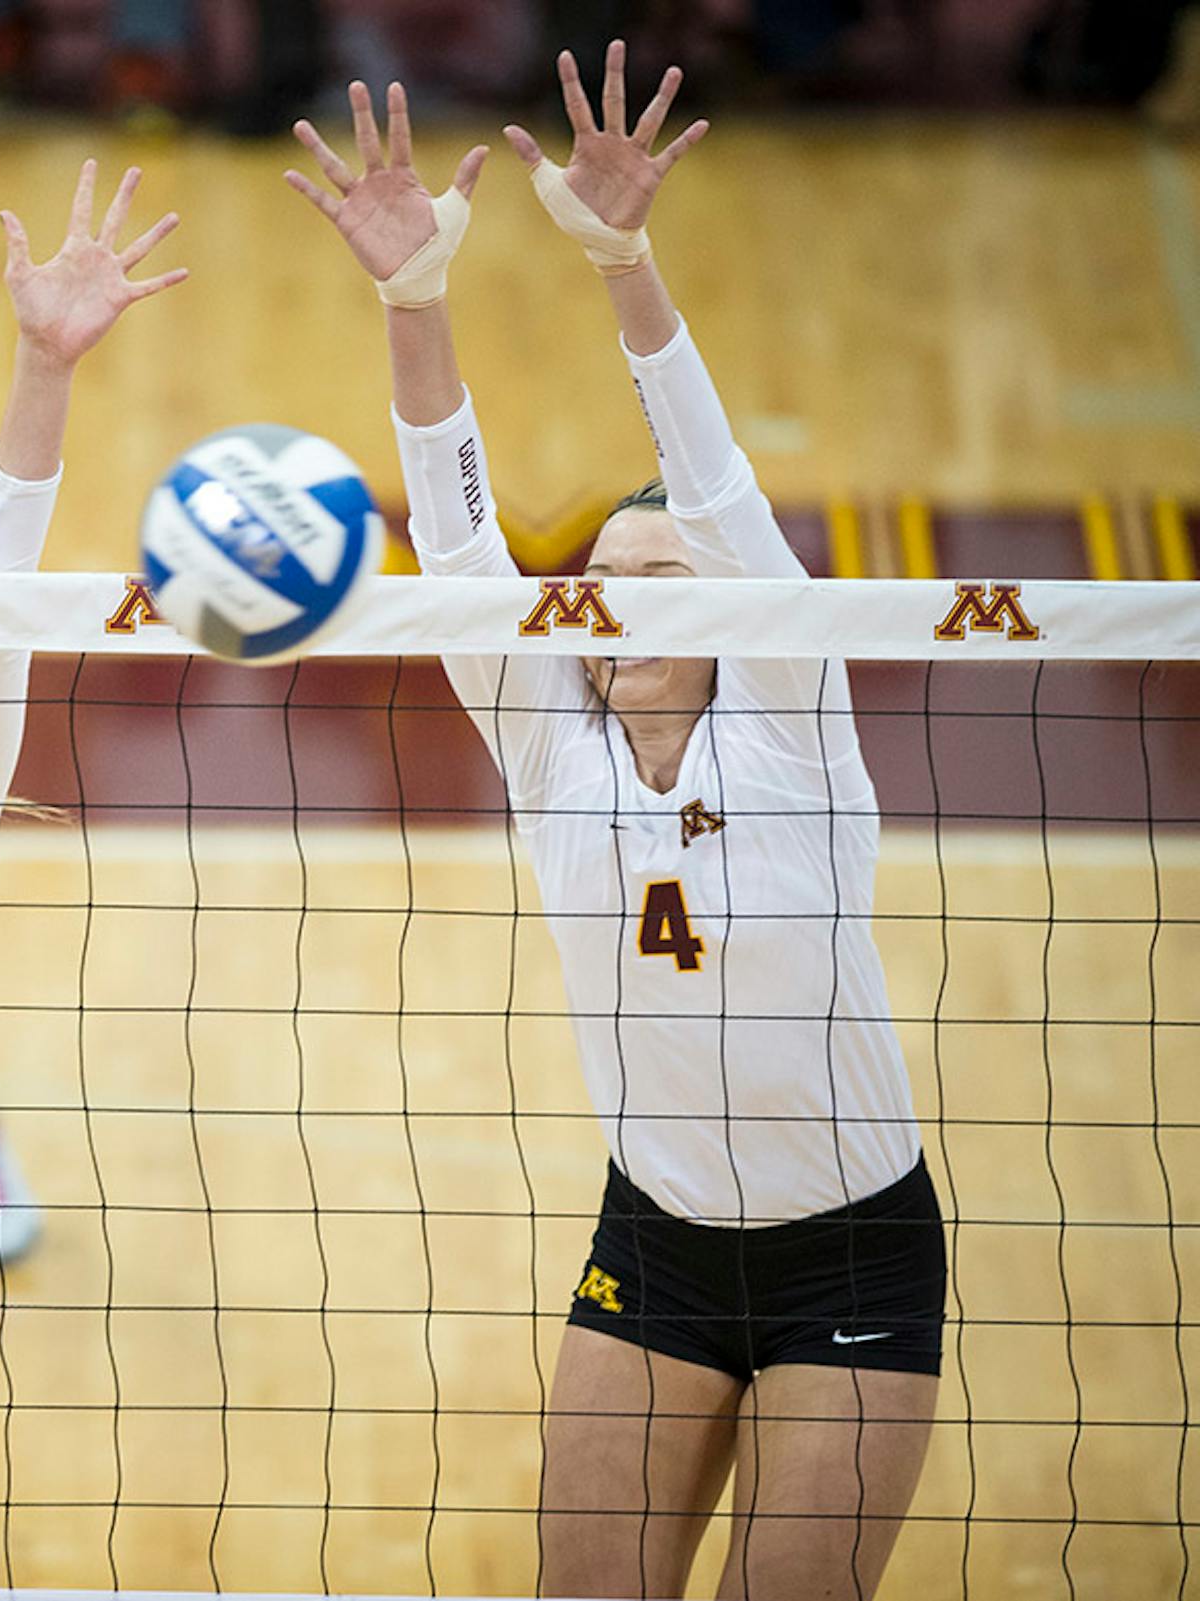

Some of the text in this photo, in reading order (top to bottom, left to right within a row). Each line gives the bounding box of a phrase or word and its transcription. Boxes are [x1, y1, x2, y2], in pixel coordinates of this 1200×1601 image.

[457, 437, 485, 531] GOPHER
[518, 579, 623, 637] M
[934, 582, 1039, 641] M
[637, 879, 706, 972] 4
